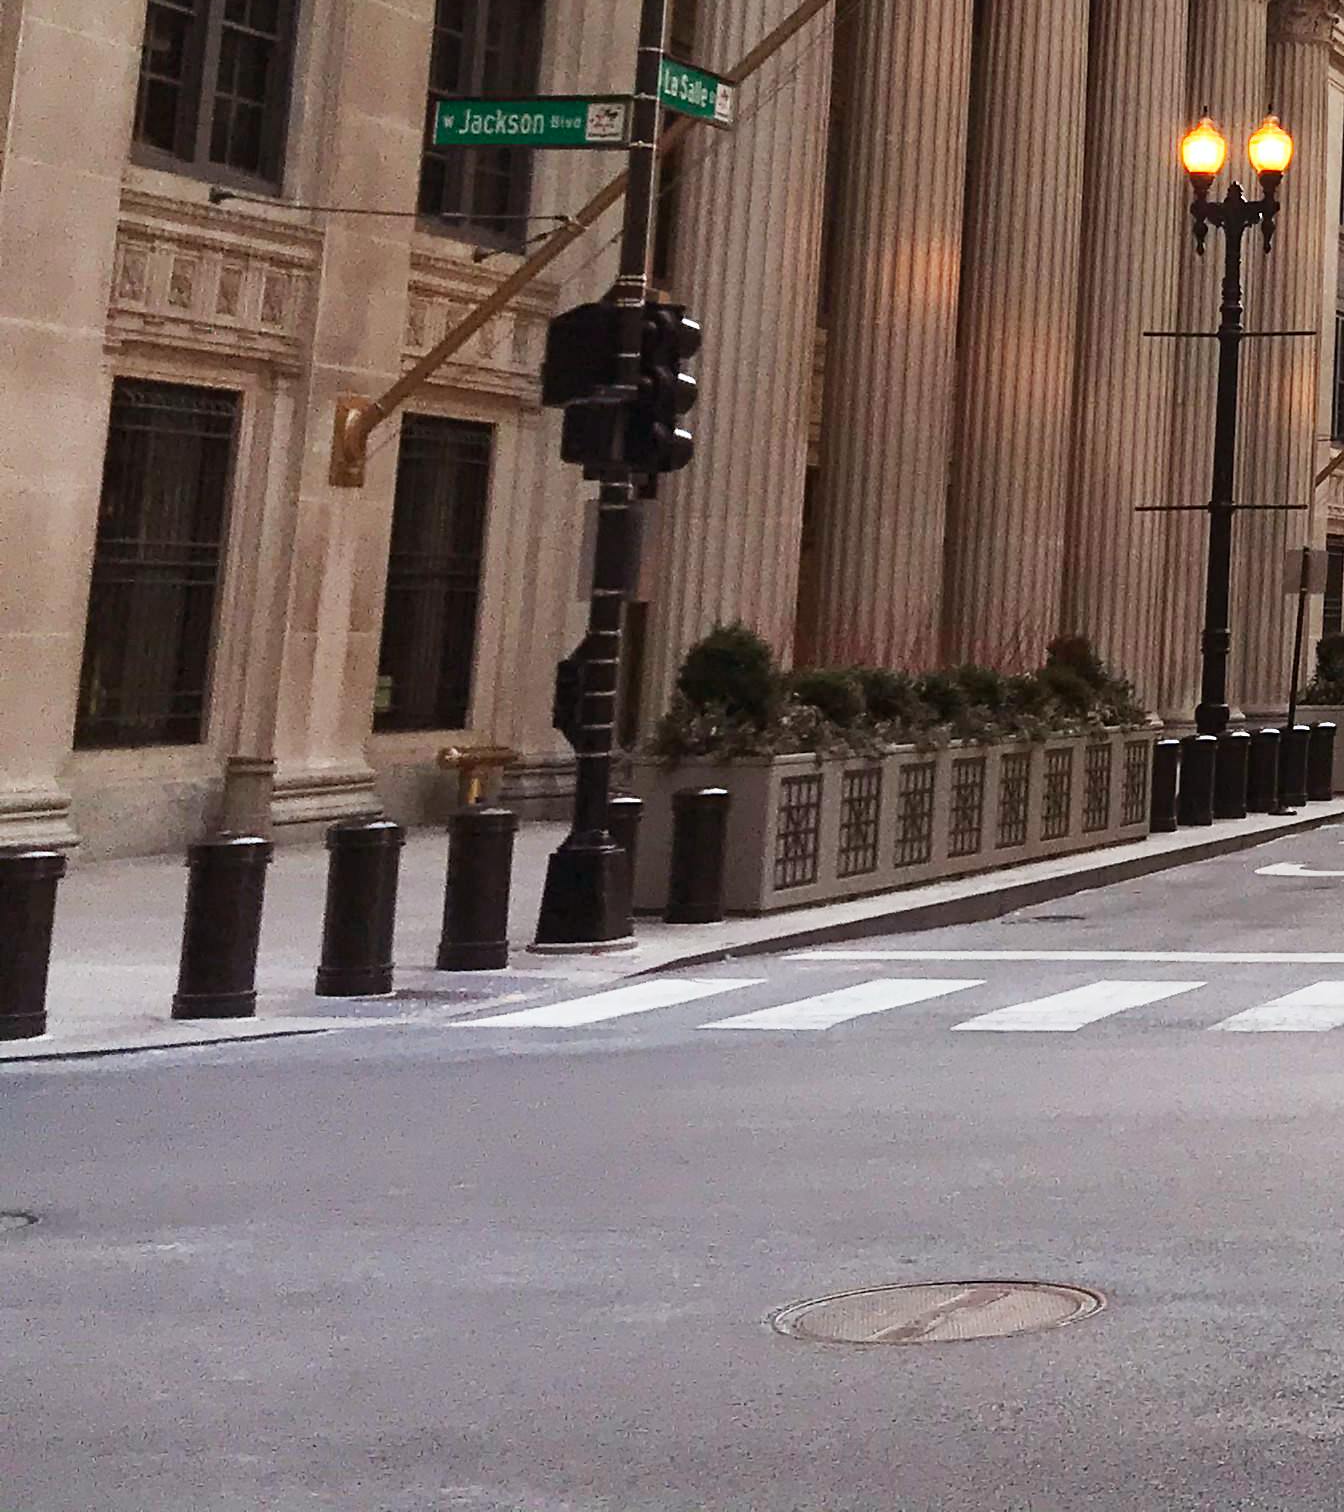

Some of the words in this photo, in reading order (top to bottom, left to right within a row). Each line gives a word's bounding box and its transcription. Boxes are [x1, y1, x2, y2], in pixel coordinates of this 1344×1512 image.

[443, 114, 454, 129] W
[458, 98, 545, 135] Jackson
[551, 114, 582, 129] Blvd
